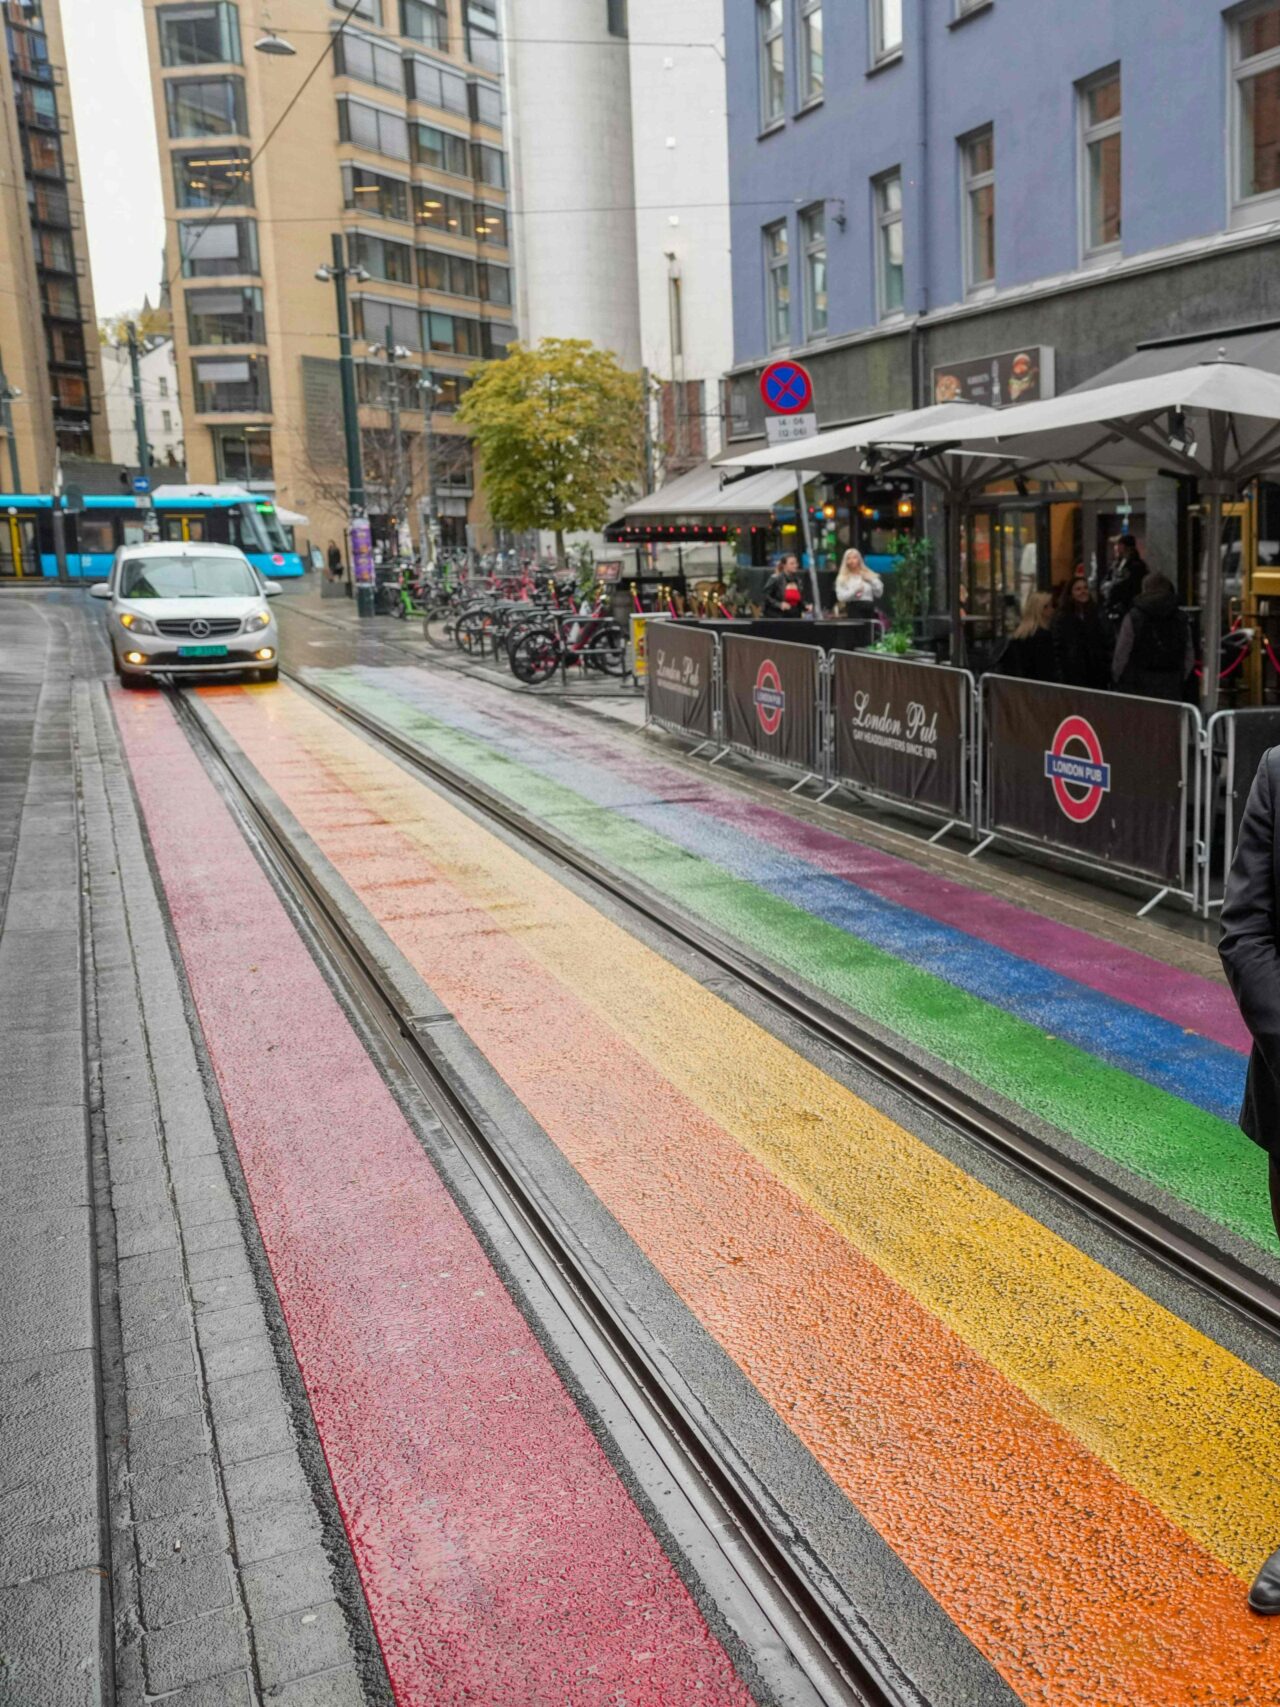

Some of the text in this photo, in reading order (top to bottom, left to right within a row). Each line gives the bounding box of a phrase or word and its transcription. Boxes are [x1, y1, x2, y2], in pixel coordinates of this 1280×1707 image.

[657, 648, 699, 687] London Pub
[852, 690, 937, 744] London Pub
[906, 742, 923, 757] SINCE
[1052, 760, 1102, 782] LONDON PUB
